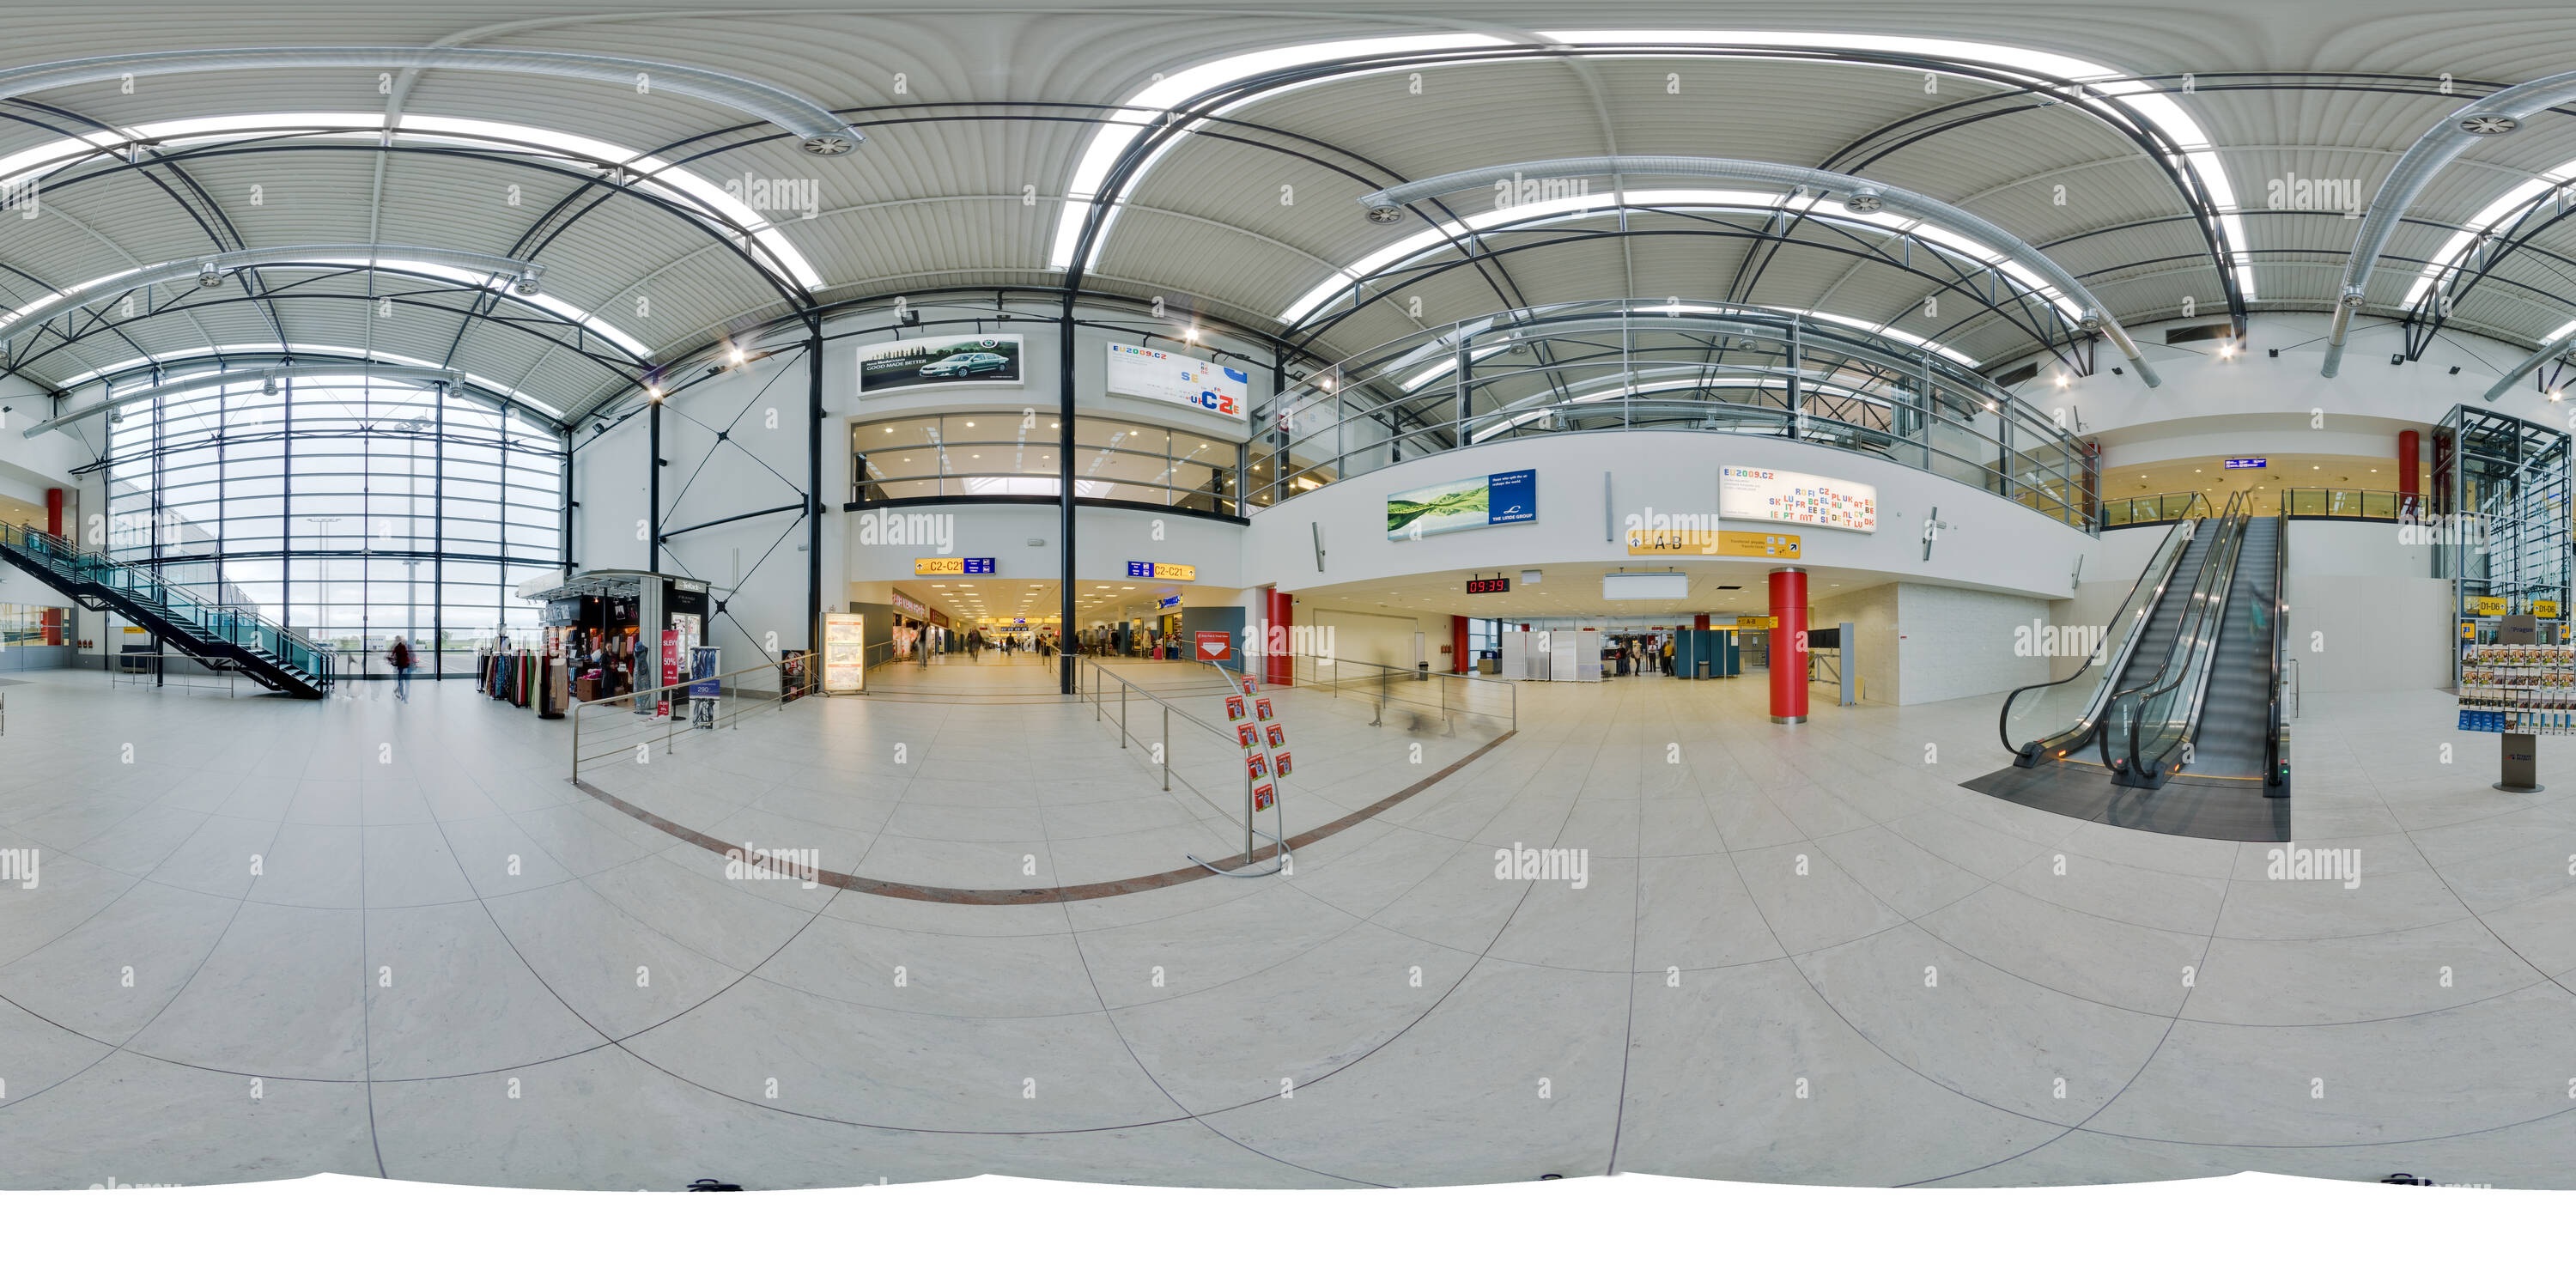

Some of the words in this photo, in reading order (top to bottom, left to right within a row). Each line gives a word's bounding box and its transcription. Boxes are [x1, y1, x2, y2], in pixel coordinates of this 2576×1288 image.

[1182, 371, 1199, 383] SE
[1724, 468, 1774, 480] EU2009.CZ
[1656, 536, 1681, 550] A-B
[930, 561, 963, 571] C2-C21
[1155, 565, 1182, 576] C2-C21
[1470, 580, 1504, 592] 09:39
[2481, 602, 2500, 611] D1-D6
[2539, 605, 2555, 613] D1-D6
